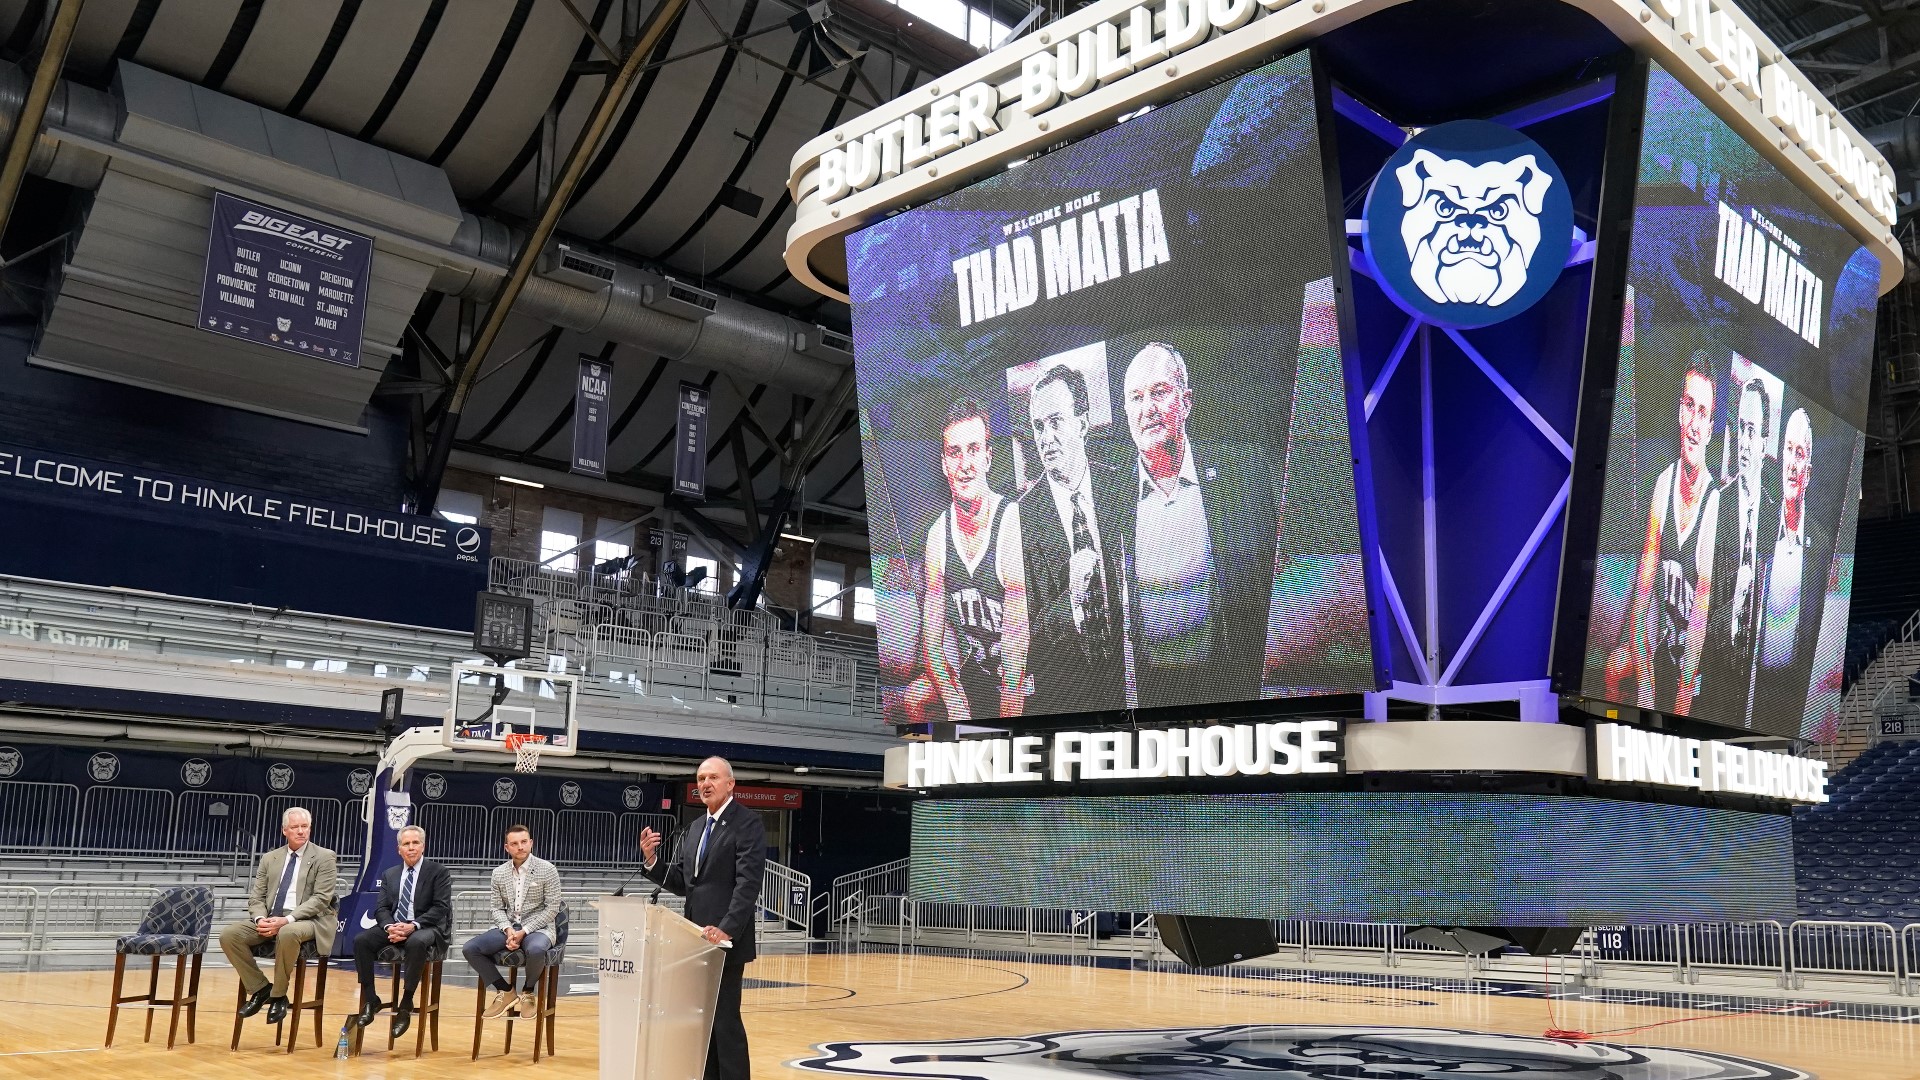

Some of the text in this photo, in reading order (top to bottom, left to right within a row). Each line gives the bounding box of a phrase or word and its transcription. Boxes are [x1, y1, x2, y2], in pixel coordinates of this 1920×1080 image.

[818, 82, 1001, 204] BUTLER
[1761, 63, 1898, 228] BULLDOGS
[1002, 191, 1101, 236] WELCOME HOME
[1751, 208, 1802, 256] WELCOME HOME
[237, 247, 261, 263] BUTLER
[286, 241, 344, 261] CONFERENCE
[952, 188, 1171, 327] THAD MATTA
[234, 262, 259, 278] DEPAUL
[280, 259, 302, 274] UCONN
[1714, 200, 1823, 349] THAD MATTA
[217, 274, 257, 293] PROVIDENCE
[267, 272, 311, 292] GEORGETOWN
[320, 271, 354, 289] CREIGHTON
[220, 291, 255, 309] VILLANOVA
[268, 288, 305, 307] SETON HALL
[318, 286, 354, 304] MARQUETTE
[316, 301, 348, 318] ST. JOHN'S
[315, 316, 337, 331] XAVIER
[581, 375, 607, 396] NCAA
[681, 401, 706, 415] CONFERENCE
[578, 457, 600, 469] VOLLEYBALL
[133, 475, 174, 501] TO
[181, 484, 283, 520] HINKLE
[288, 502, 447, 548] FIELDHOUSE
[650, 536, 662, 546] 213
[674, 540, 686, 550] 214
[456, 553, 479, 562] pepsi
[1884, 721, 1902, 733] 218
[907, 720, 1339, 788] HINKLE FIELDHOUSE
[1598, 723, 1830, 803] HINKLE FIELDHOUSE
[735, 792, 752, 800] TRASH
[753, 793, 776, 801] SERVICE
[793, 892, 803, 905] 112
[1602, 932, 1622, 949] 118
[599, 958, 635, 974] BUTLER
